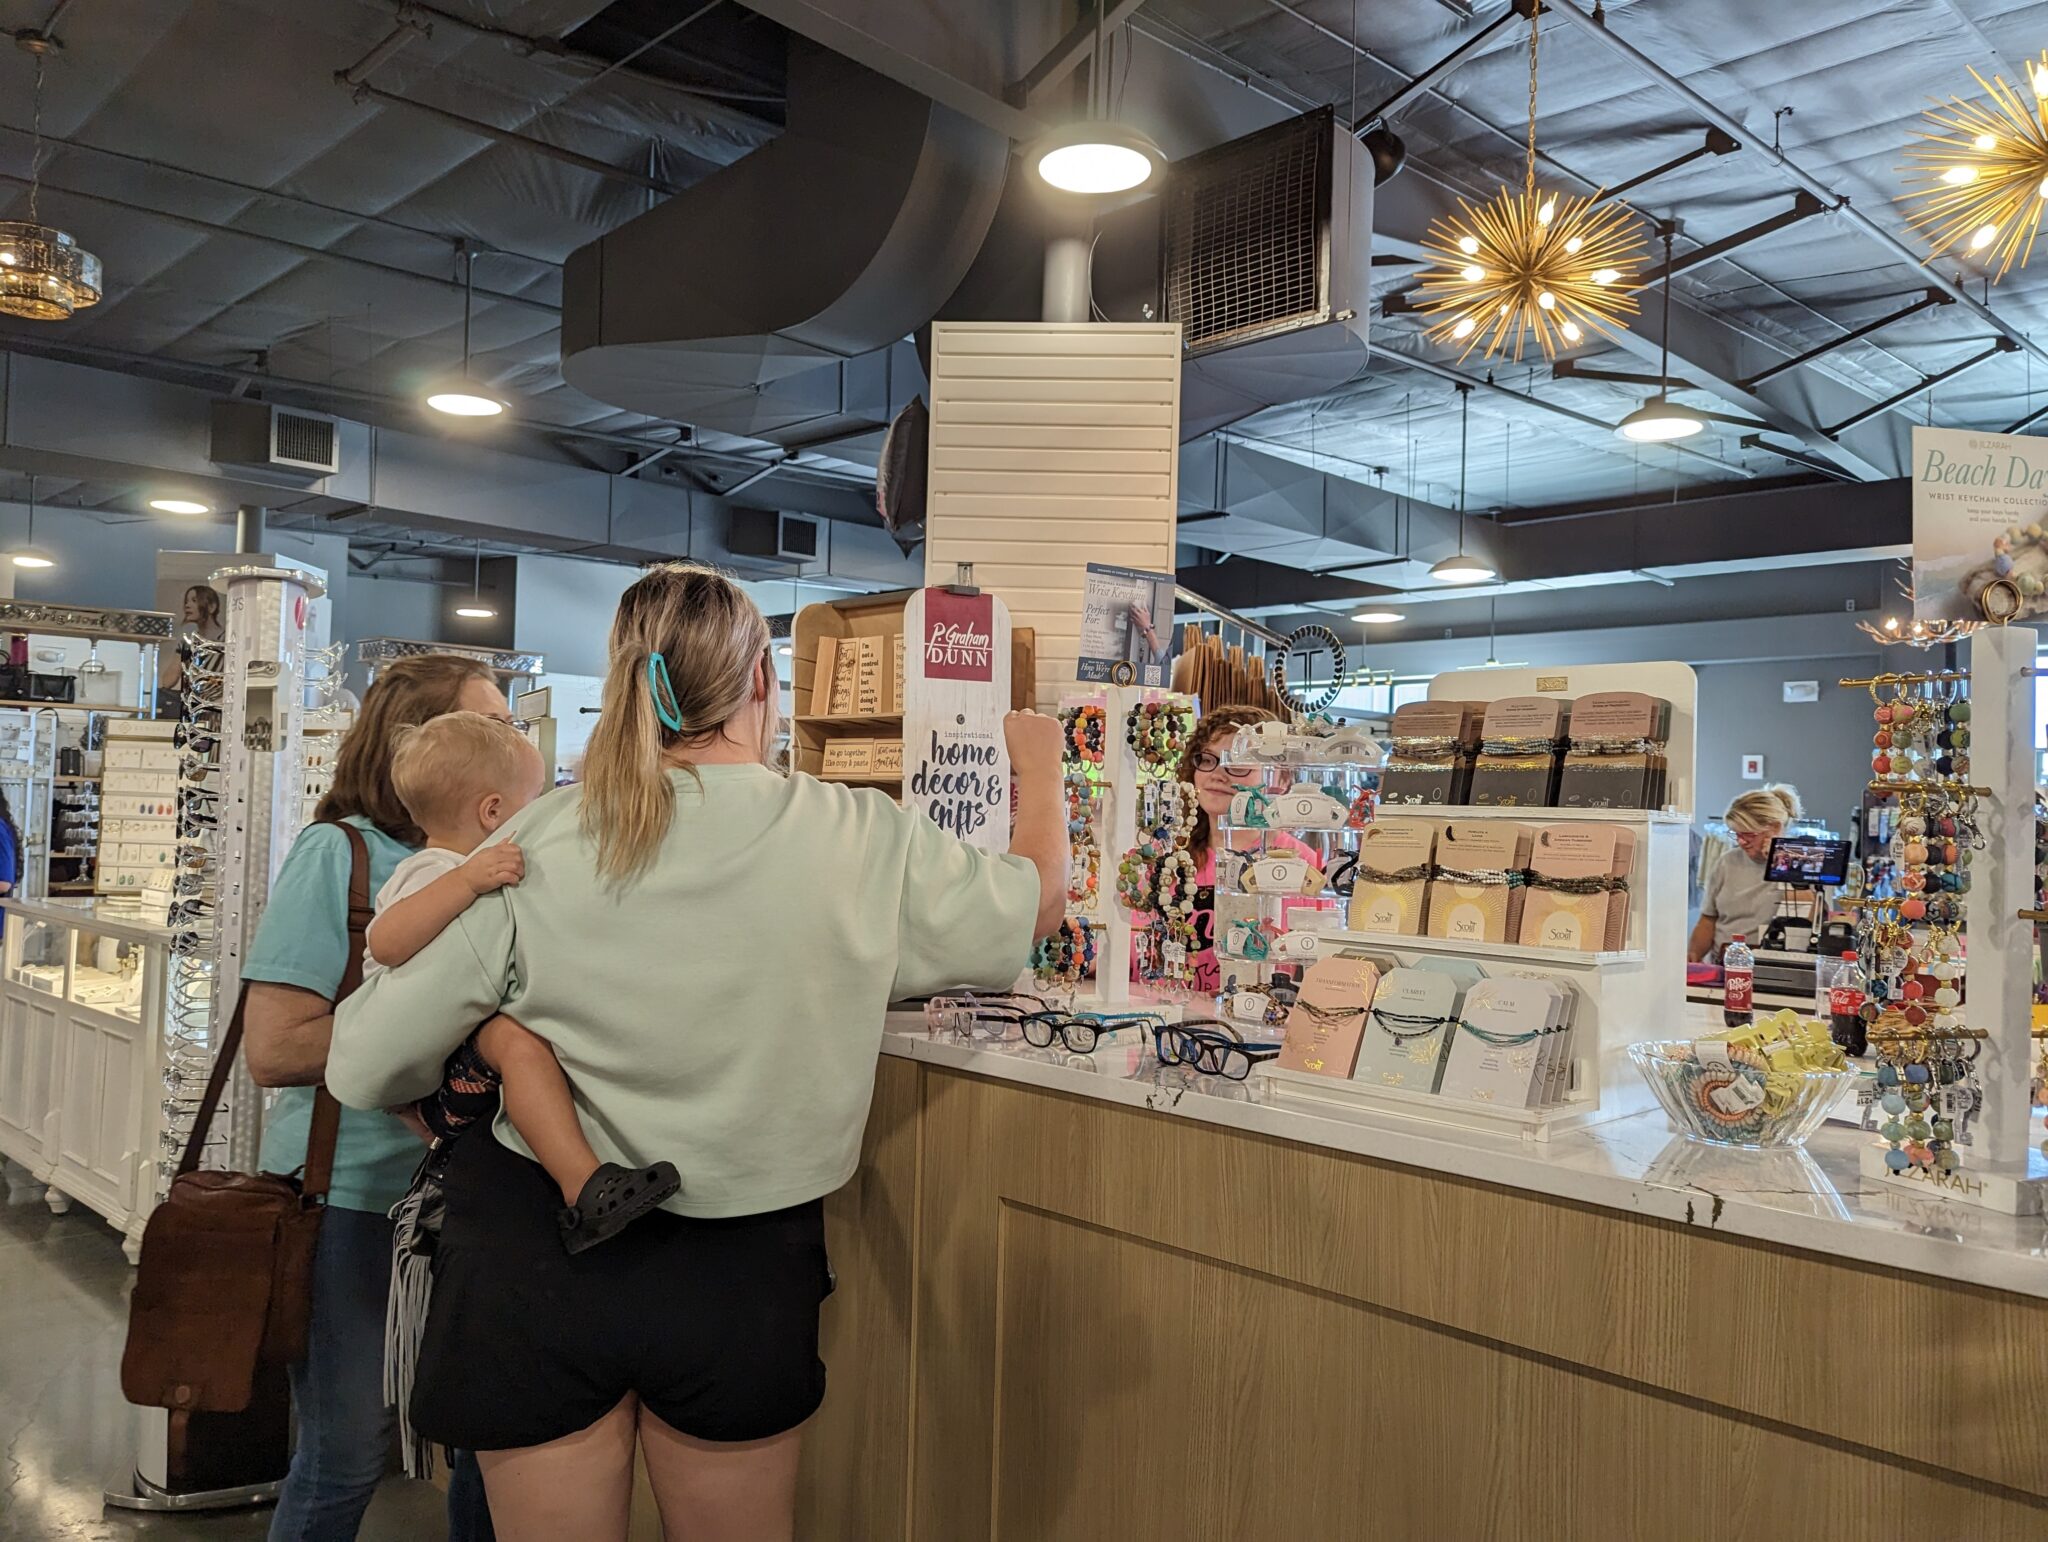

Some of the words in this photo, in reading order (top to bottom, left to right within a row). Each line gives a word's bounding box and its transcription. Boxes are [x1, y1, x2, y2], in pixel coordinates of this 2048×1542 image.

[1921, 449, 1997, 487] Beach
[2004, 455, 2048, 498] Da
[1929, 492, 1955, 501] WRIST
[1958, 494, 2001, 504] KEYCHAIN
[1088, 583, 1110, 597] Wrist
[1111, 585, 1147, 602] Keychain
[1086, 603, 1110, 617] Perfect
[945, 621, 989, 653] Graham
[930, 647, 988, 667] DUNN
[944, 731, 993, 739] inspirational
[844, 749, 867, 757] together
[931, 729, 999, 766] home
[911, 760, 985, 797] décor
[986, 774, 1002, 806] &
[929, 798, 988, 841] gifts
